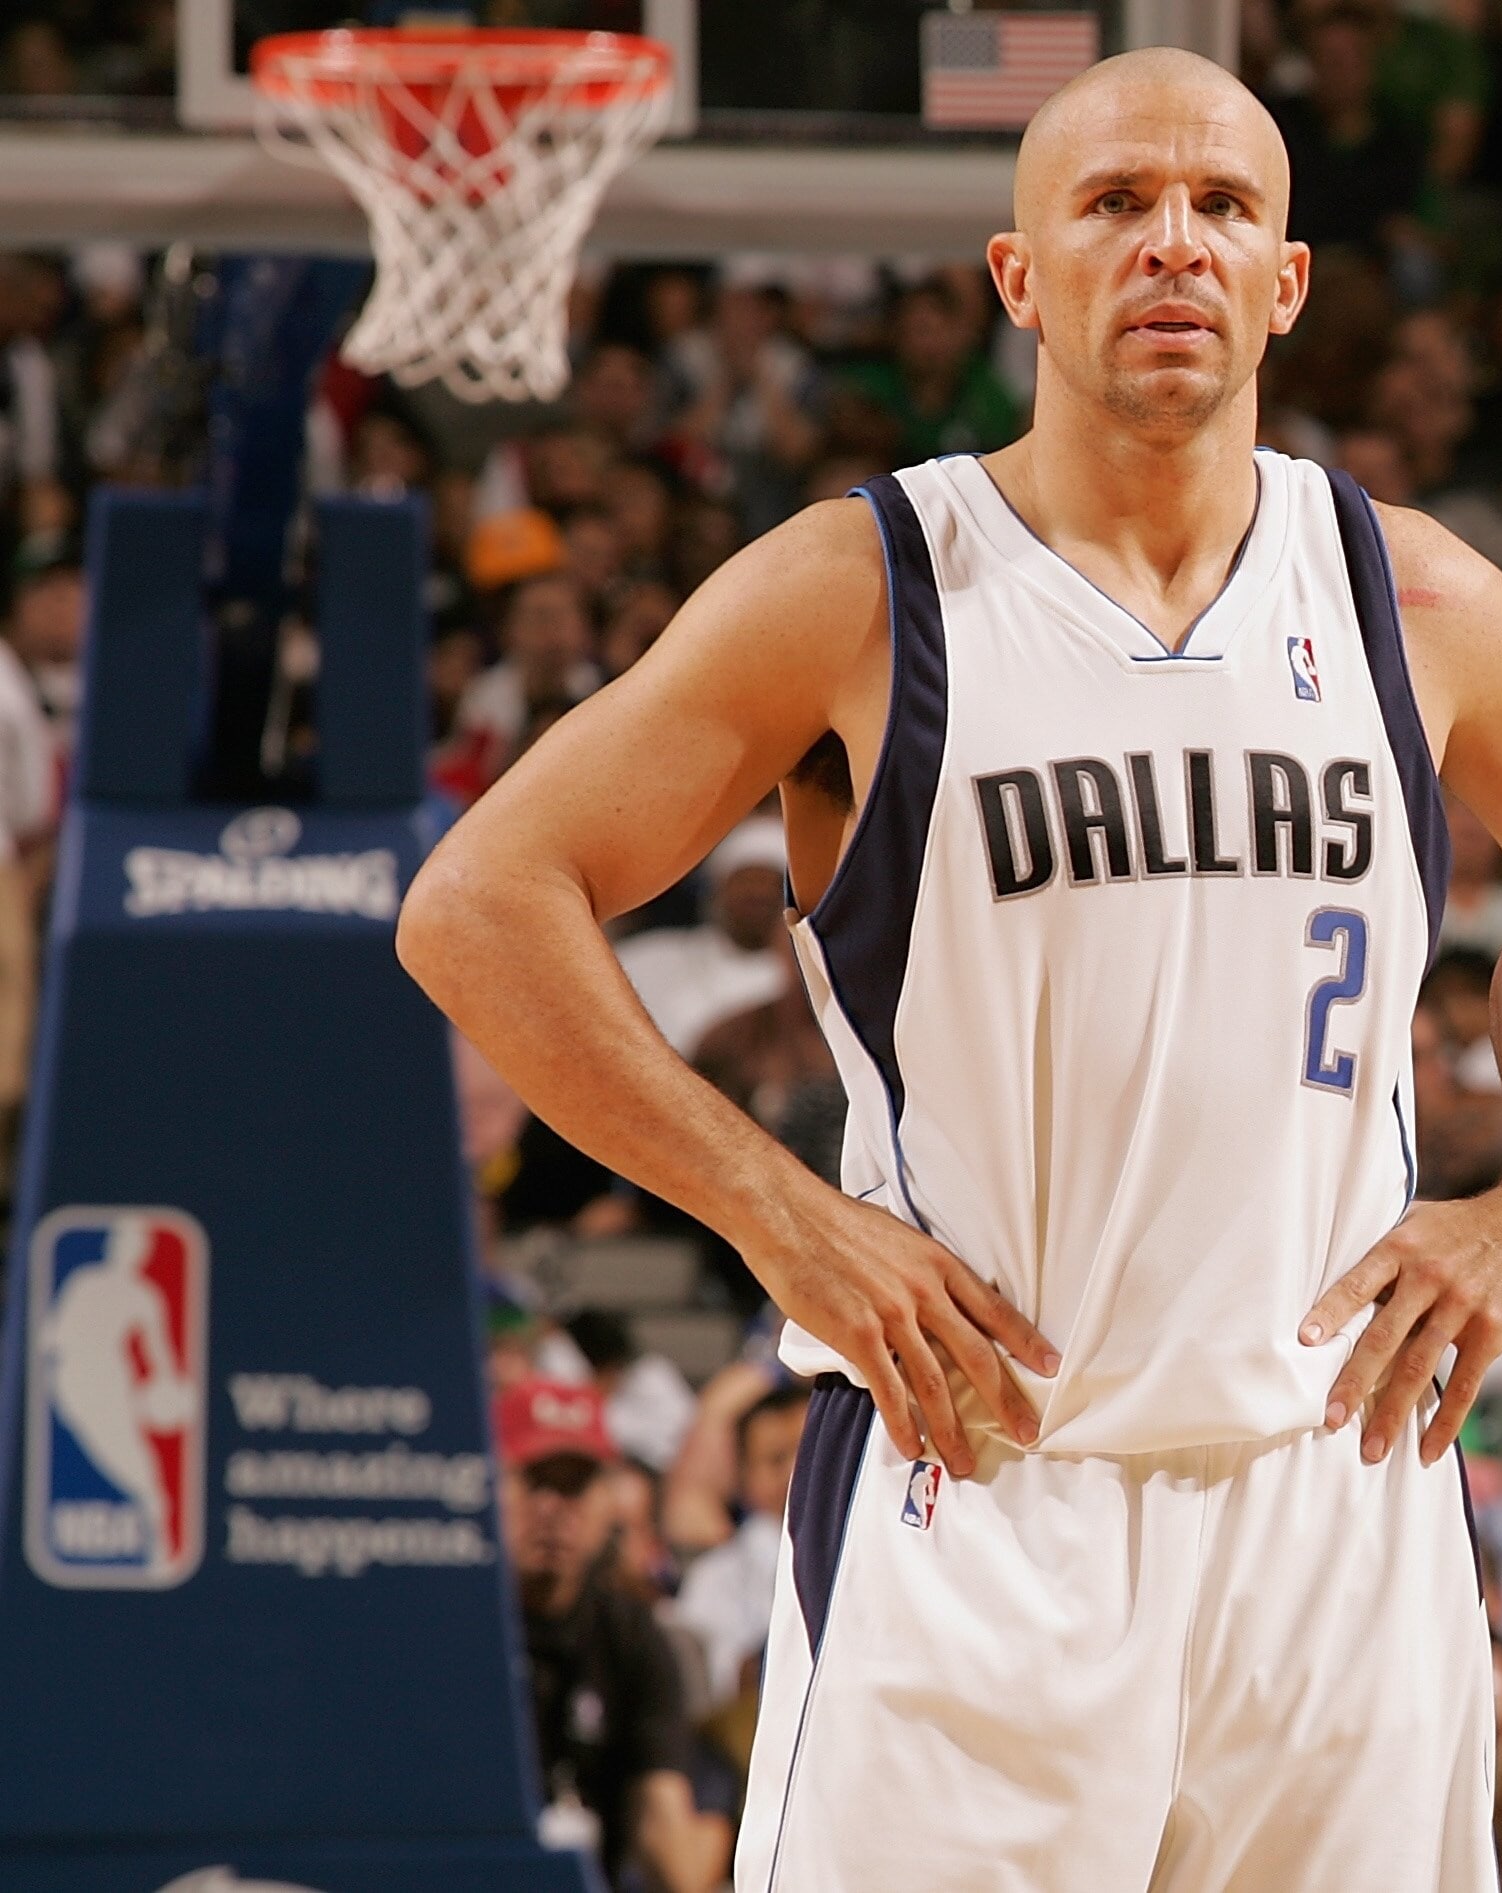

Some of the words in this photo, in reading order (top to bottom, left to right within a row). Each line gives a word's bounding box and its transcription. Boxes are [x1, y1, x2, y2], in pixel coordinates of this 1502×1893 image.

[971, 748, 1373, 902] DALLAS
[1300, 904, 1369, 1097] 2
[228, 1372, 431, 1436] Where
[224, 1439, 488, 1515] amazing
